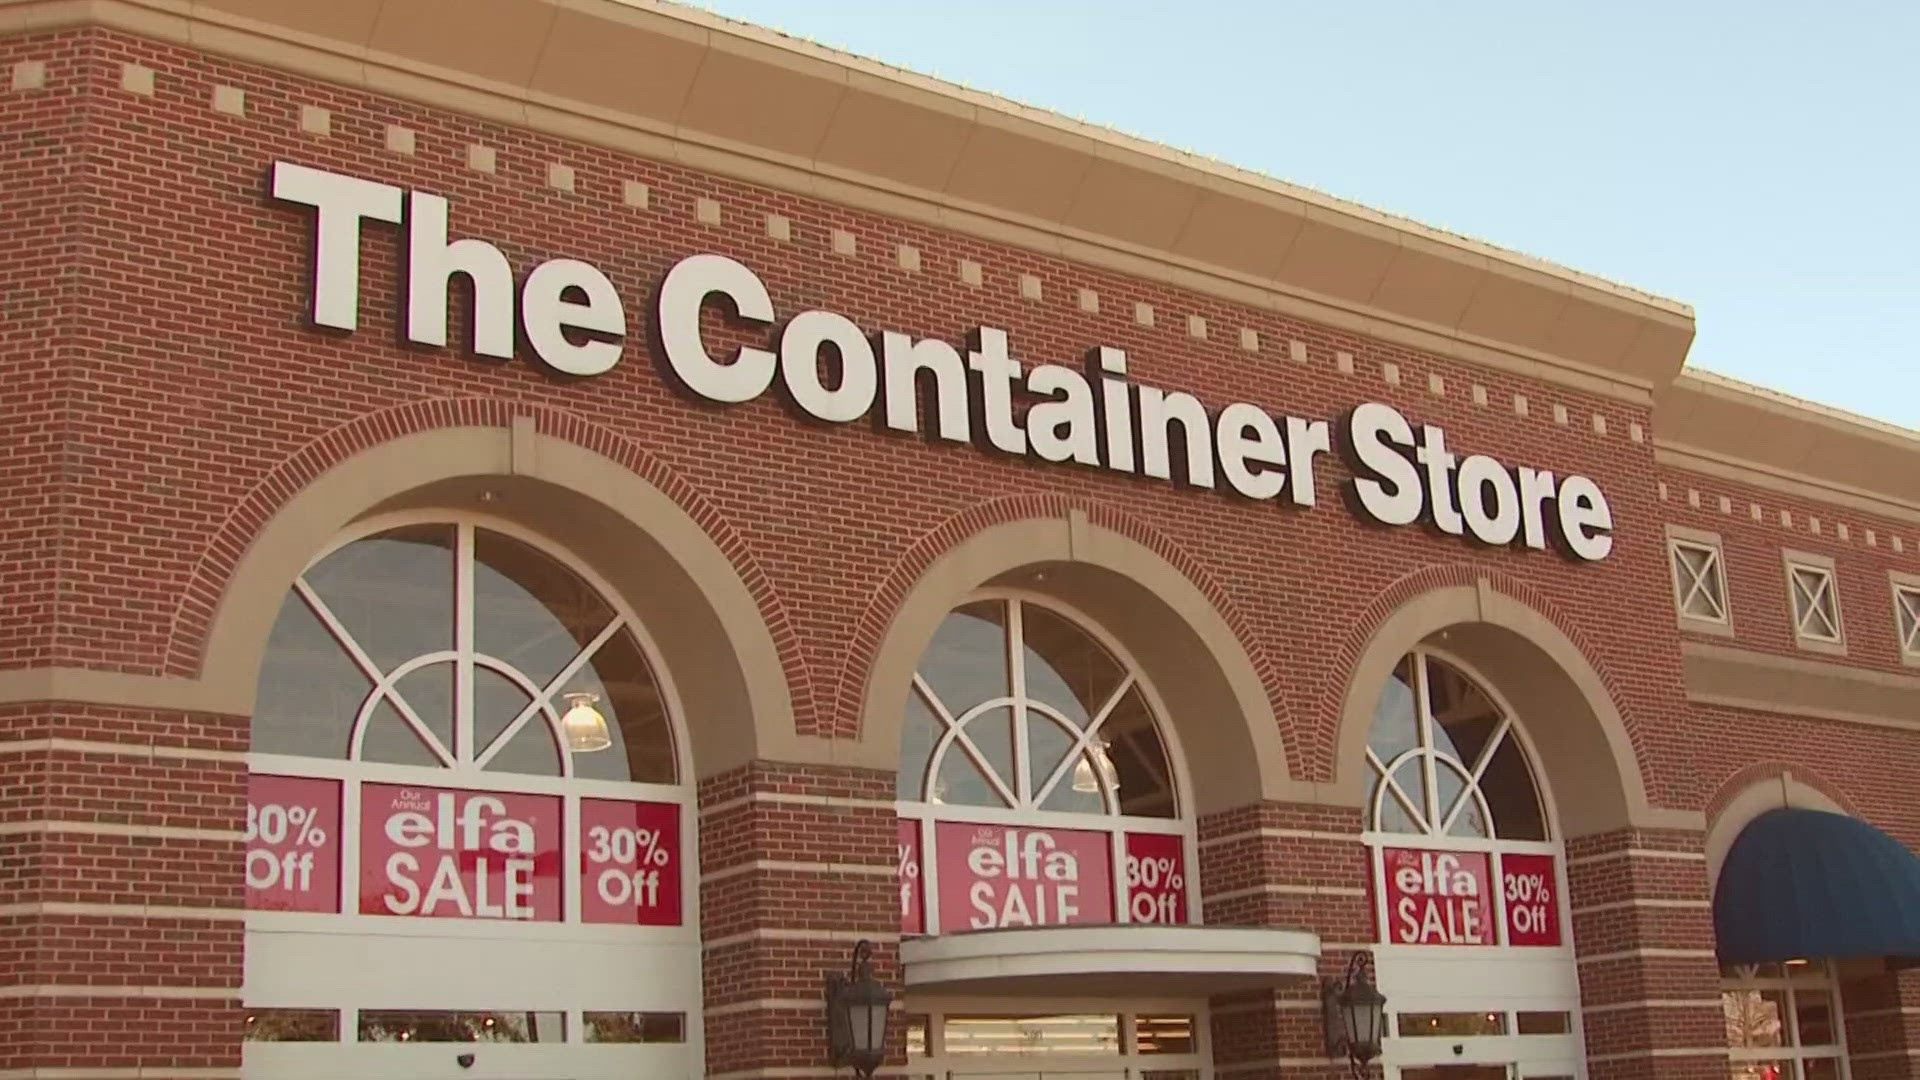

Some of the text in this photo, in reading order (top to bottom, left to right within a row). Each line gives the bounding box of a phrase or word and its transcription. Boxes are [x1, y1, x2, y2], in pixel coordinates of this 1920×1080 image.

[273, 160, 1614, 561] The Container Store
[383, 792, 536, 854] elfa
[588, 826, 669, 867] 30%
[967, 830, 1079, 882] elfa
[245, 849, 315, 892] Off
[383, 852, 535, 919] SALE
[597, 868, 660, 907] Off
[1126, 854, 1184, 890] 30%
[1395, 852, 1479, 897] elfa
[1504, 873, 1550, 903] 30%
[1131, 891, 1178, 925] Off
[1397, 896, 1482, 944] SALE
[1512, 904, 1547, 934] Off
